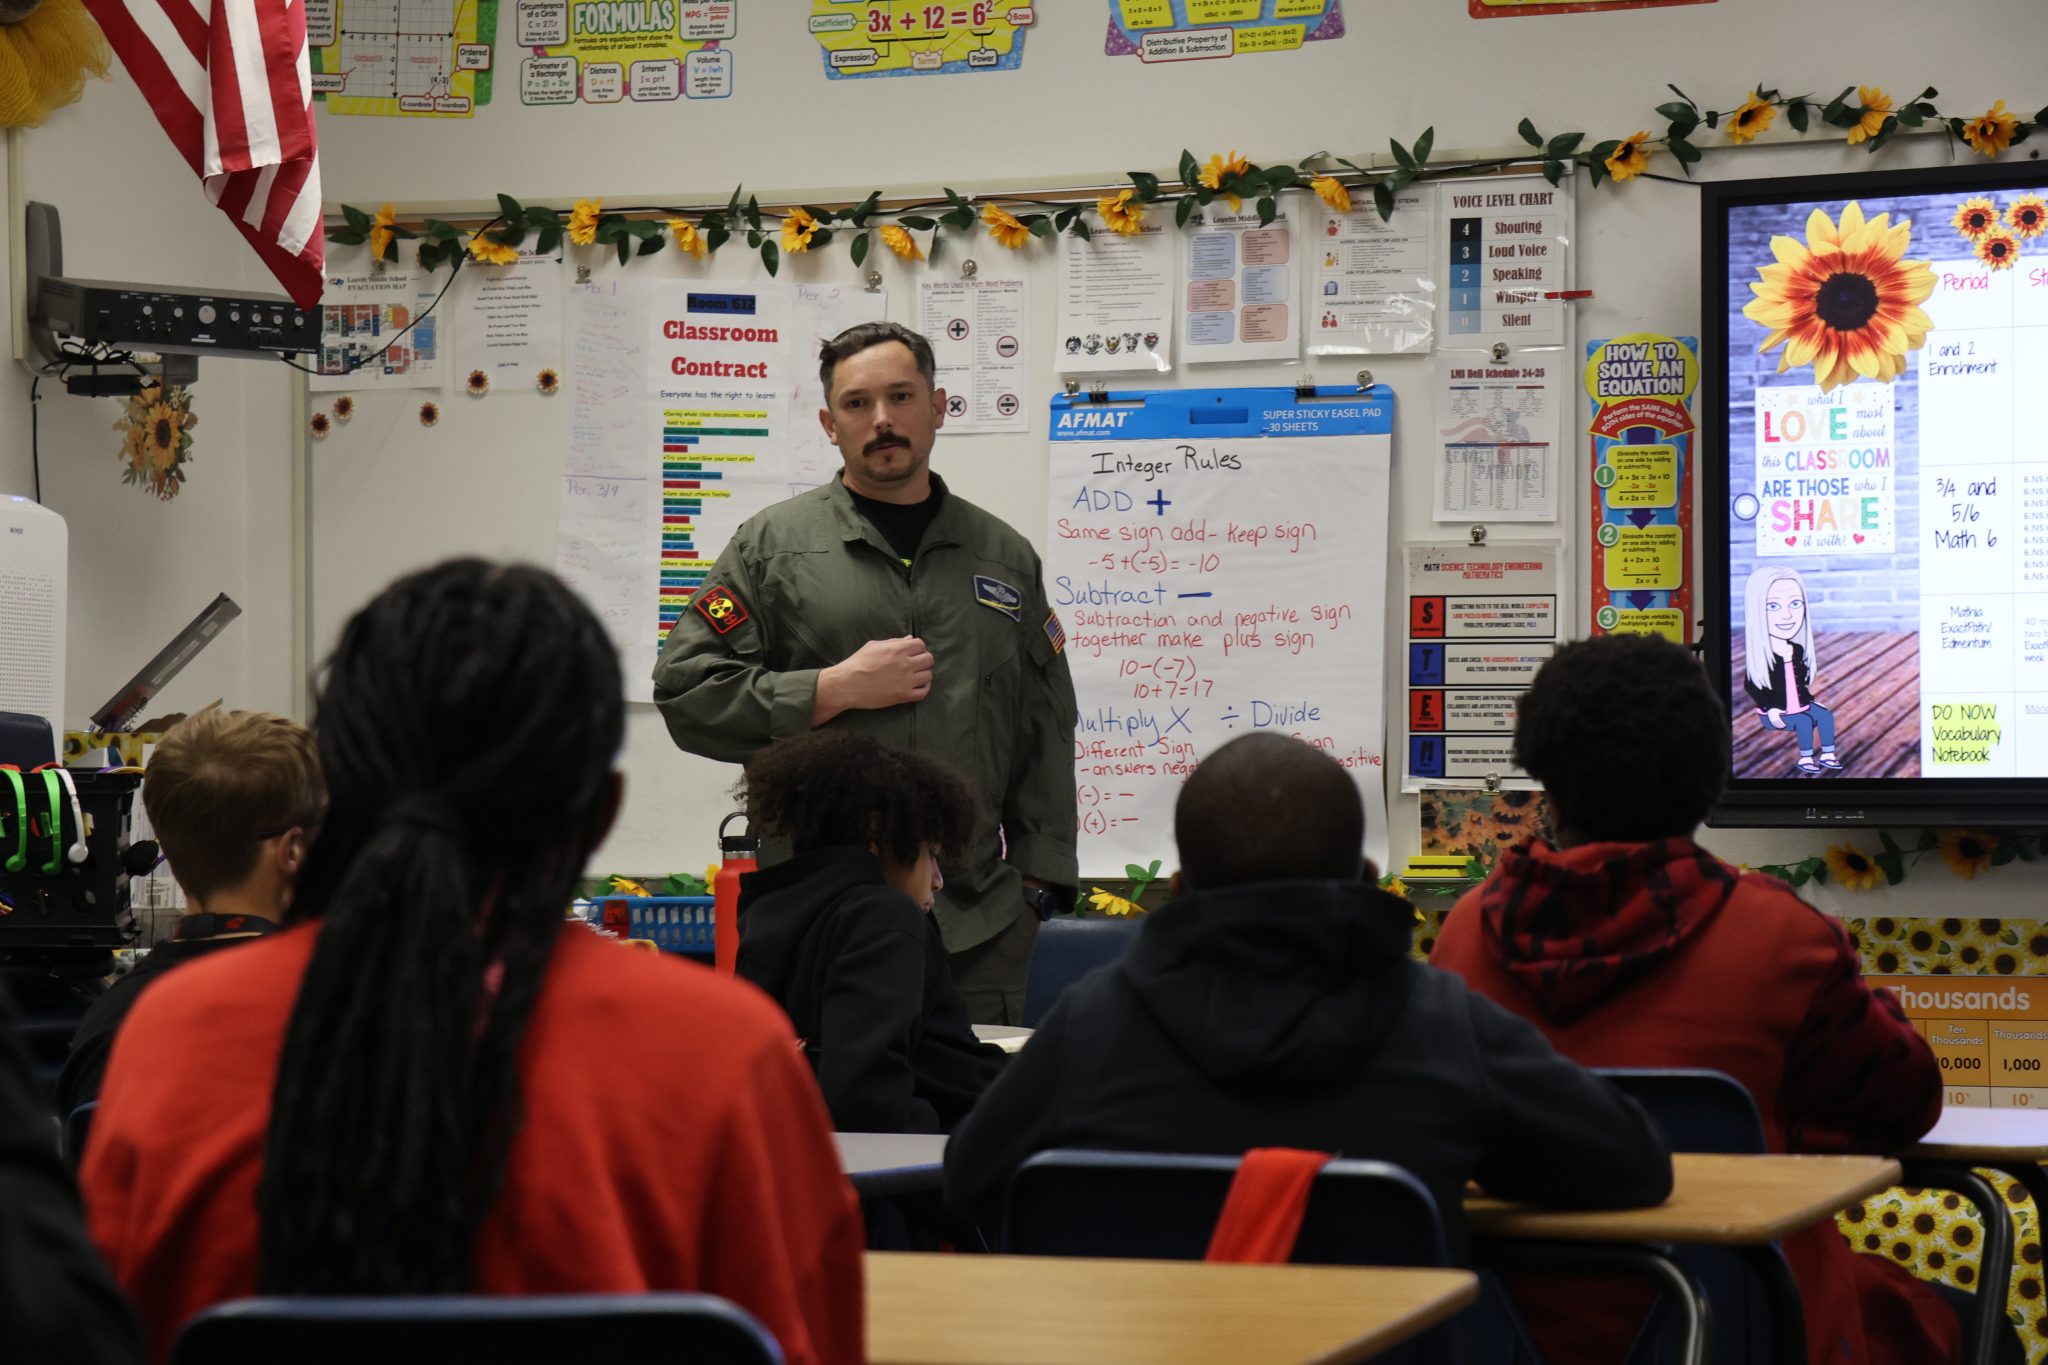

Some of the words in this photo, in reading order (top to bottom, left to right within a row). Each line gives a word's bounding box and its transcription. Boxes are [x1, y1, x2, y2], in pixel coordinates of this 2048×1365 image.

[519, 2, 564, 11] Circumference
[540, 10, 558, 18] Circle
[573, 0, 675, 35] FORMULAS
[684, 11, 702, 19] MPG
[812, 16, 852, 28] Coefficient
[868, 9, 892, 32] 3x
[923, 5, 945, 30] 12
[1013, 12, 1030, 20] Base
[1146, 38, 1186, 48] Distributive
[1187, 35, 1217, 46] Property
[1219, 33, 1228, 41] of
[834, 52, 871, 63] Expression
[1148, 47, 1177, 56] Addition
[1186, 43, 1227, 53] Subtraction
[529, 62, 560, 70] Perimeter
[562, 61, 569, 69] of
[696, 56, 720, 64] Volume
[917, 57, 937, 65] Terms
[971, 54, 994, 63] Power
[536, 69, 567, 78] Rectangle
[590, 67, 617, 75] Distance
[641, 64, 667, 73] Interest
[1453, 195, 1483, 209] VOICE
[1486, 193, 1516, 207] LEVEL
[1519, 192, 1553, 206] CHART
[1462, 222, 1470, 236] 4
[1495, 220, 1542, 235] Shouting
[1462, 246, 1470, 259] 3
[1489, 245, 1515, 257] Loud
[1518, 244, 1547, 256] Voice
[1462, 269, 1470, 282] 2
[1492, 266, 1542, 283] Speaking
[1943, 271, 1989, 291] Period
[688, 296, 727, 309] Room
[731, 297, 755, 310] 612
[1462, 293, 1467, 305] 1
[1496, 291, 1538, 305] Whisper
[1462, 317, 1469, 327] 0
[1502, 314, 1531, 327] Silent
[663, 320, 778, 343] Classroom
[1605, 342, 1649, 362] HOW
[1654, 342, 1678, 361] TO
[1939, 342, 1961, 357] and
[1967, 341, 1975, 355] 2
[671, 356, 768, 378] Contract
[1467, 368, 1483, 379] Bell
[1485, 368, 1520, 379] Schedule
[1522, 368, 1545, 378] 24-25
[1599, 360, 1653, 379] SOLVE
[1659, 359, 1685, 377] AN
[1928, 359, 1998, 377] Enrichment
[1598, 377, 1685, 397] EQUATION
[660, 390, 692, 400] Everyone
[695, 391, 707, 399] has
[711, 391, 722, 399] the
[725, 391, 743, 401] right
[756, 392, 775, 400] learn!
[1807, 392, 1835, 406] what
[1838, 389, 1844, 405] I
[1057, 411, 1127, 429] AFMAT
[1263, 410, 1293, 420] SUPER
[1294, 409, 1329, 420] STICKY
[1331, 408, 1361, 418] EASEL
[1362, 407, 1382, 417] PAD
[1602, 407, 1629, 422] Perform
[1629, 403, 1640, 411] the
[1641, 403, 1661, 412] SAME
[1661, 407, 1675, 418] step
[1856, 405, 1884, 419] most
[1282, 421, 1319, 431] SHEETS
[1601, 417, 1620, 432] BOTH
[1619, 412, 1636, 422] sides
[1636, 410, 1644, 418] of
[1644, 411, 1656, 419] the
[1656, 414, 1686, 431] equation.
[1764, 407, 1848, 443] LOVE
[1057, 429, 1110, 437] www.afmat.com
[1852, 424, 1886, 439] about
[1091, 452, 1173, 482] Integer
[1176, 445, 1242, 471] Rules
[1762, 454, 1782, 468] this
[1785, 447, 1890, 472] CLASSROOM
[1602, 468, 1608, 483] 1
[1762, 479, 1792, 498] ARE
[1797, 477, 1850, 497] THOSE
[1854, 481, 1877, 492] who
[1881, 475, 1888, 491] I
[1936, 477, 1956, 498] 3/4
[1967, 476, 1996, 497] and
[1072, 485, 1133, 512] ADD
[1770, 496, 1879, 533] SHARE
[1952, 503, 1980, 523] 5/6
[1057, 518, 1111, 541] Same
[1119, 521, 1164, 553] sign
[1275, 520, 1316, 553] sign
[1603, 526, 1614, 542] 2
[1803, 536, 1812, 548] it
[1816, 534, 1847, 547] with!
[1935, 529, 1977, 549] Math
[1987, 528, 1998, 548] 6
[1424, 563, 1440, 571] MATH
[1441, 562, 1465, 571] SCIENCE
[1466, 562, 1503, 571] TECHNOLOGY
[1504, 561, 1543, 571] ENGINEERING
[1462, 571, 1503, 580] MATHEMATICS
[1055, 576, 1167, 606] Subtract
[1074, 609, 1176, 627] Subtraction
[1187, 609, 1223, 628] and
[1234, 604, 1300, 635] negative
[1311, 603, 1351, 630] sign
[1422, 602, 1434, 624] S
[1603, 609, 1613, 625] 3
[1071, 631, 1148, 658] together
[1157, 631, 1204, 648] make
[1223, 630, 1262, 657] plus
[1275, 630, 1315, 655] sign
[1422, 648, 1434, 671] T
[1251, 700, 1321, 728] Divide
[1421, 695, 1433, 717] E
[1932, 704, 1953, 720] DO
[1960, 704, 1997, 720] NOW
[1931, 725, 2002, 746] Vocabulary
[1074, 739, 1147, 760] Different
[1158, 736, 1196, 764] Sign
[1330, 746, 1382, 768] ositive
[1932, 746, 1991, 762] Notebook
[1948, 1024, 1966, 1034] Ten
[1994, 1030, 2048, 1040] Thousands
[1932, 1035, 1985, 1045] Thousands
[2003, 1058, 2041, 1072] 1,000
